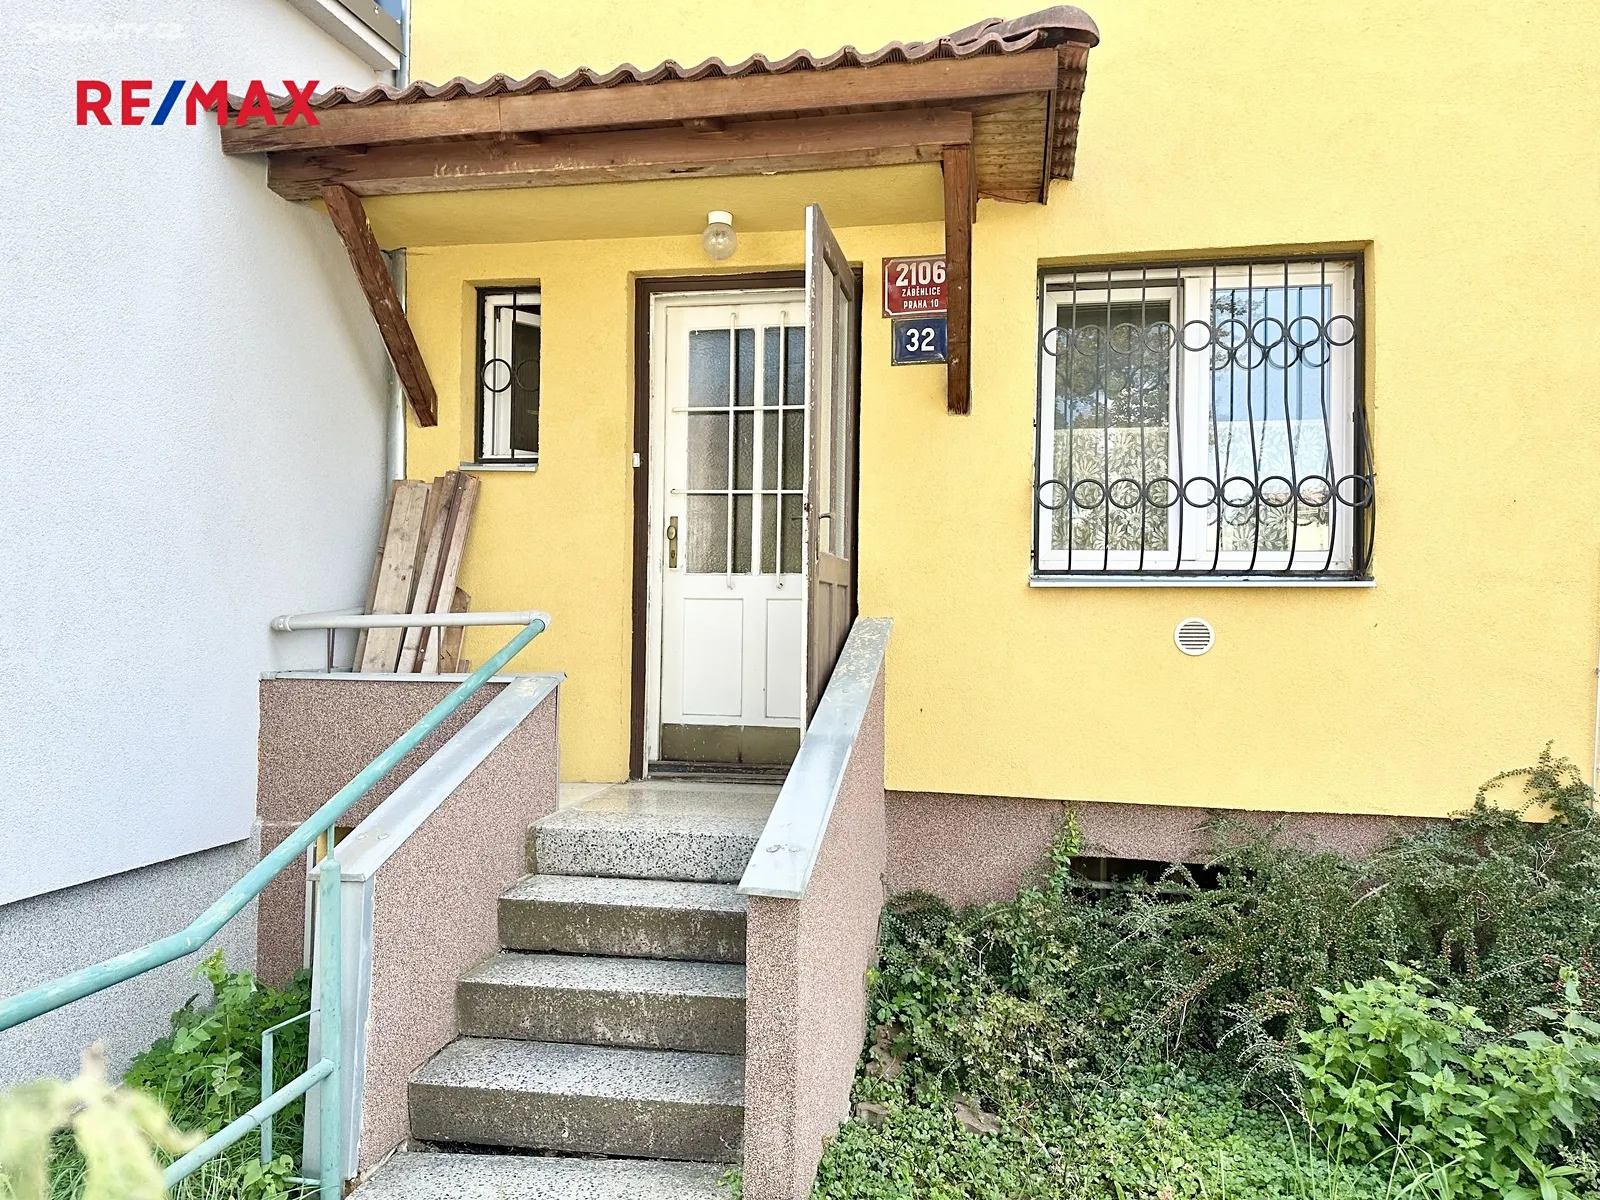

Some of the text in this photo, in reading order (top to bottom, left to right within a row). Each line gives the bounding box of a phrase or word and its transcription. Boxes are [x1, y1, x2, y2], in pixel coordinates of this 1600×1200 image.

[895, 261, 946, 287] 2106
[901, 286, 941, 297] ZÁBĚHLICE
[903, 298, 939, 309] PRAHA 10
[905, 327, 935, 352] 32
